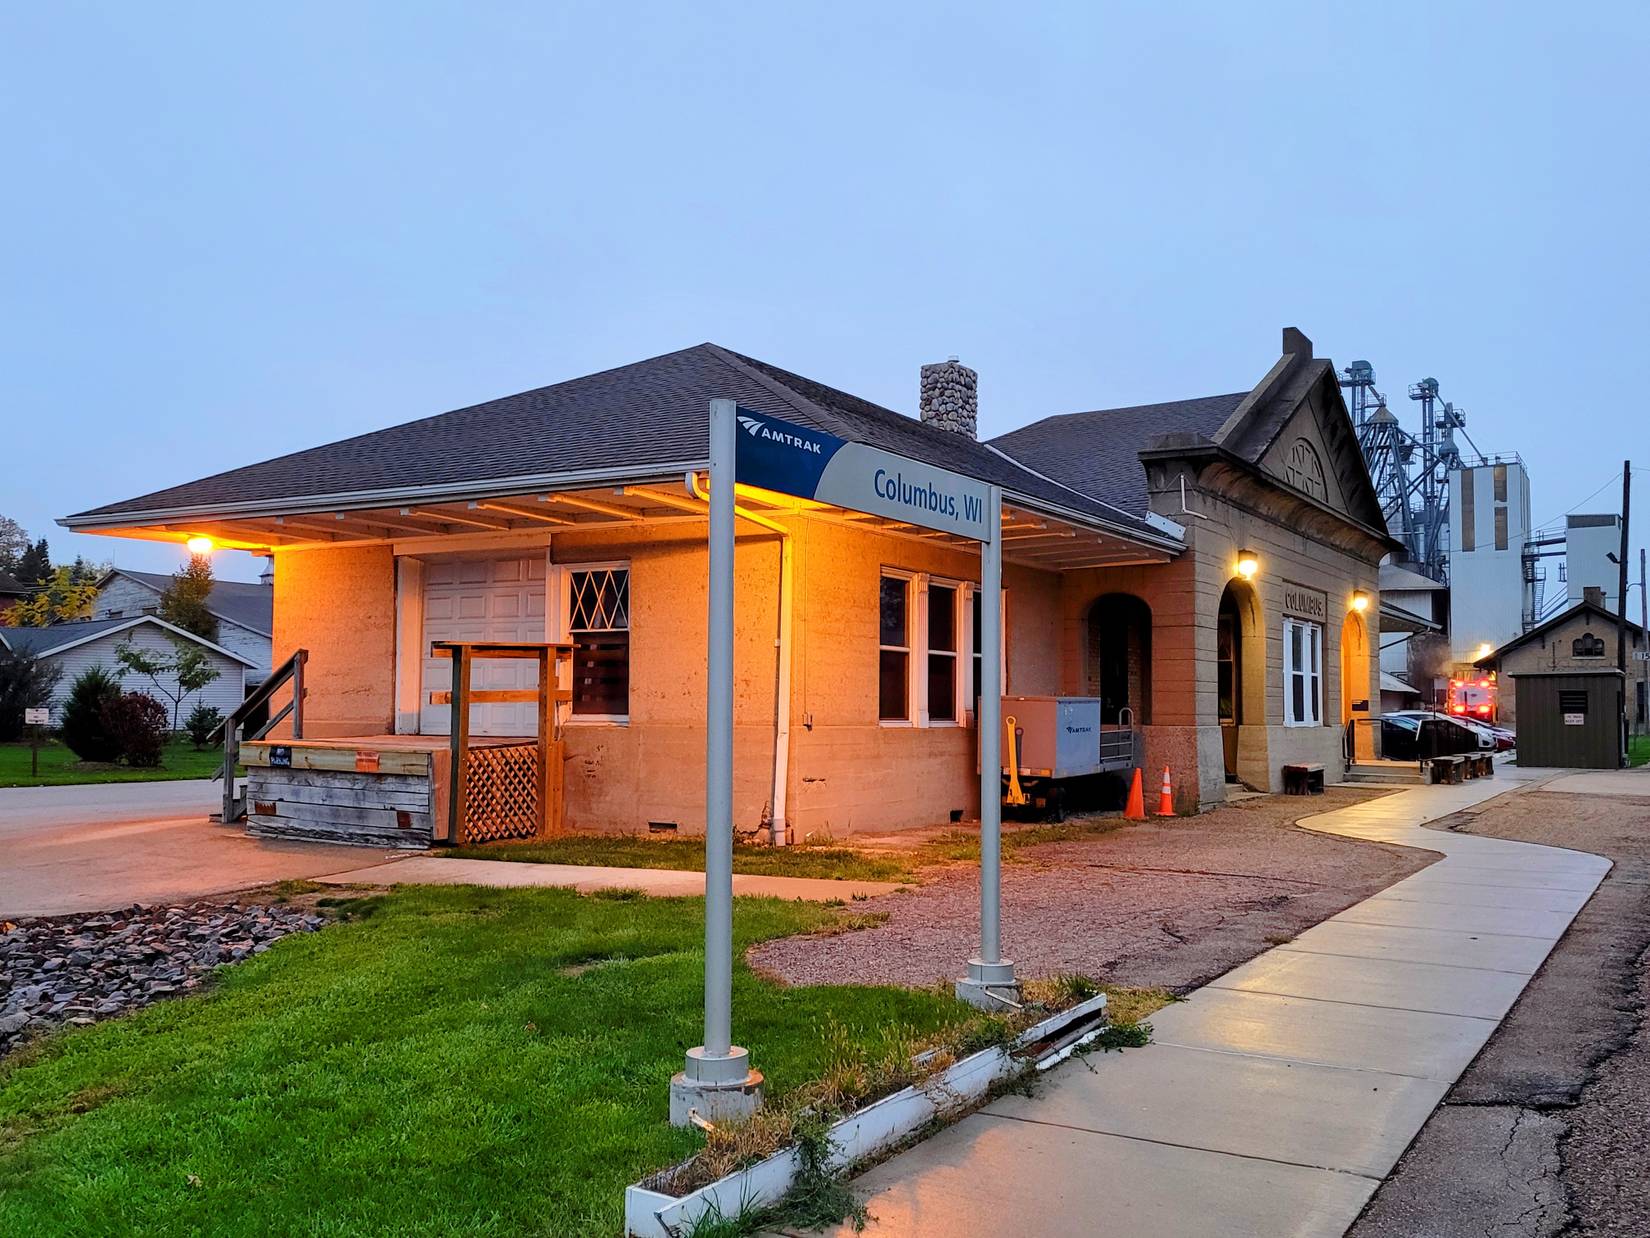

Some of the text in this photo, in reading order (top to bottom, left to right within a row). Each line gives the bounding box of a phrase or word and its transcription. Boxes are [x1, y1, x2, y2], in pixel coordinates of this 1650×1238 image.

[761, 427, 821, 454] AMTRAK
[874, 469, 982, 524] Columbus, WI
